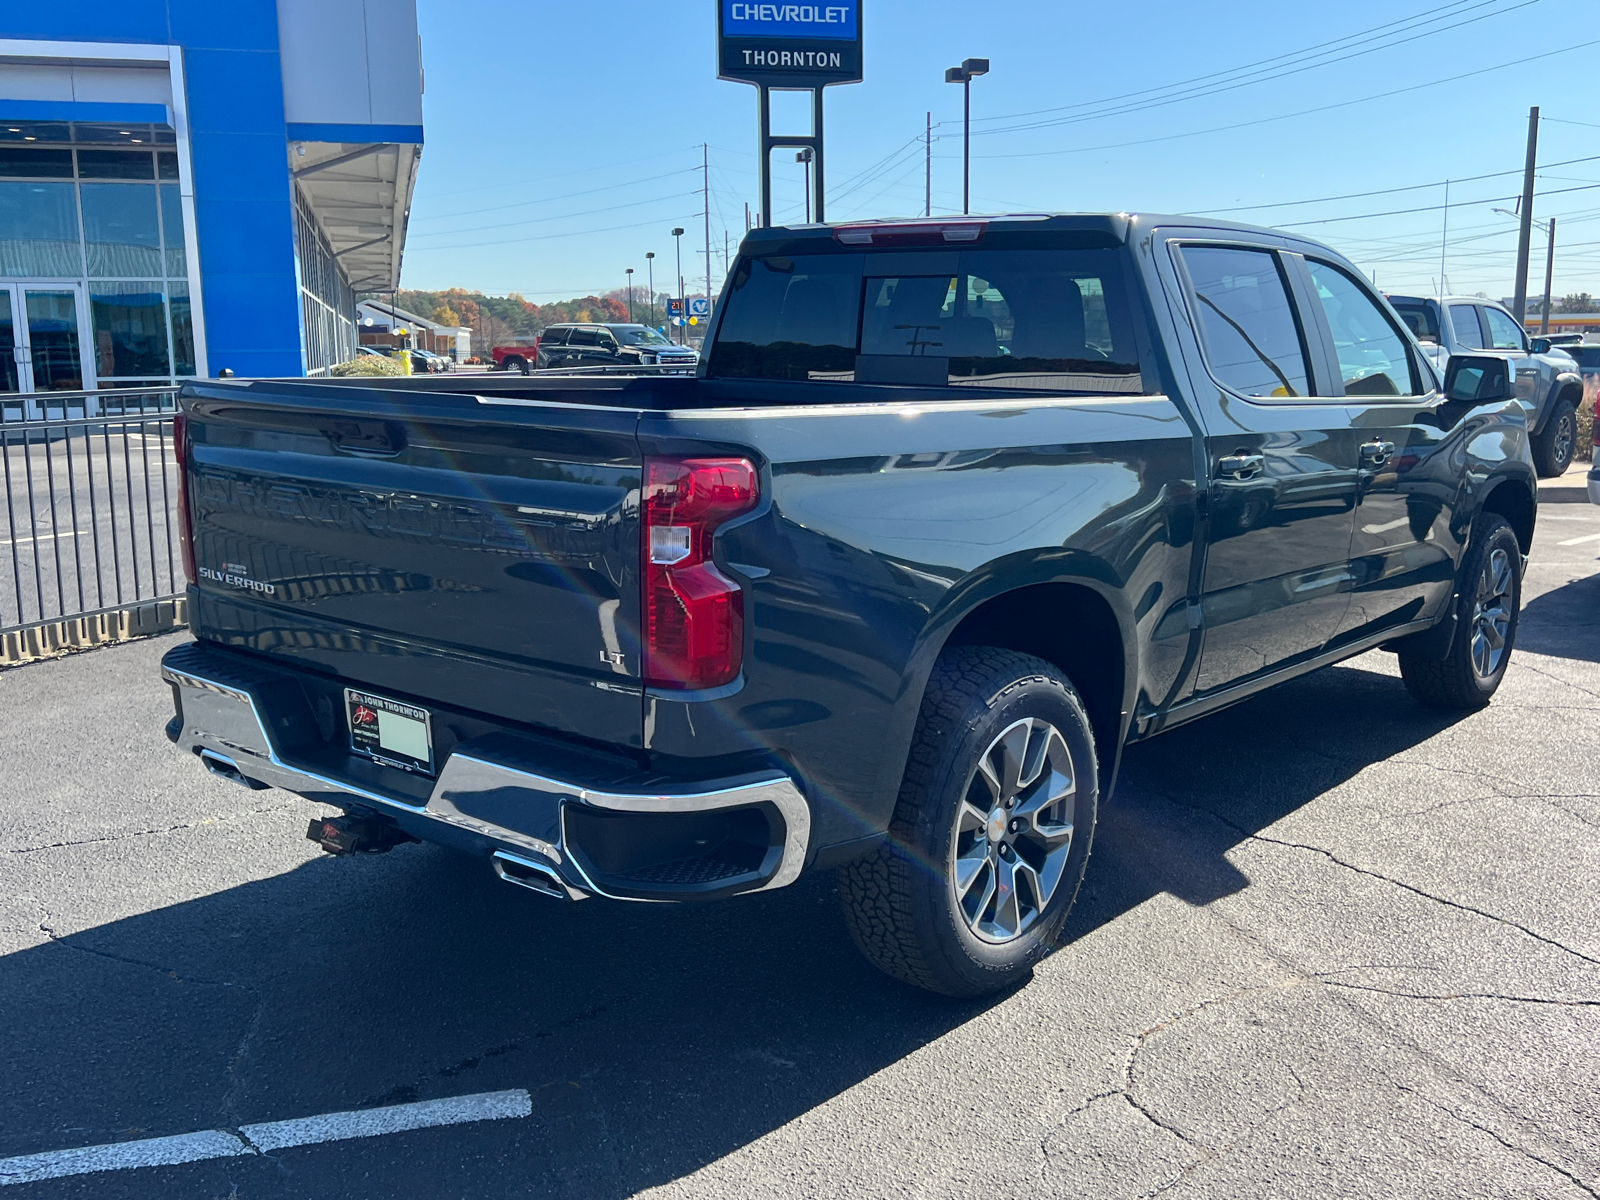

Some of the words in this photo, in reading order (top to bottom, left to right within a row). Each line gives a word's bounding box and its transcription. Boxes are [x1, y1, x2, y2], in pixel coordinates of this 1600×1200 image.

[732, 3, 849, 23] CHEVROLET
[742, 50, 841, 67] THORNTON
[199, 566, 275, 595] SILVERADO
[599, 650, 625, 665] LT
[364, 695, 384, 709] JOHN
[384, 701, 425, 720] THORNTON
